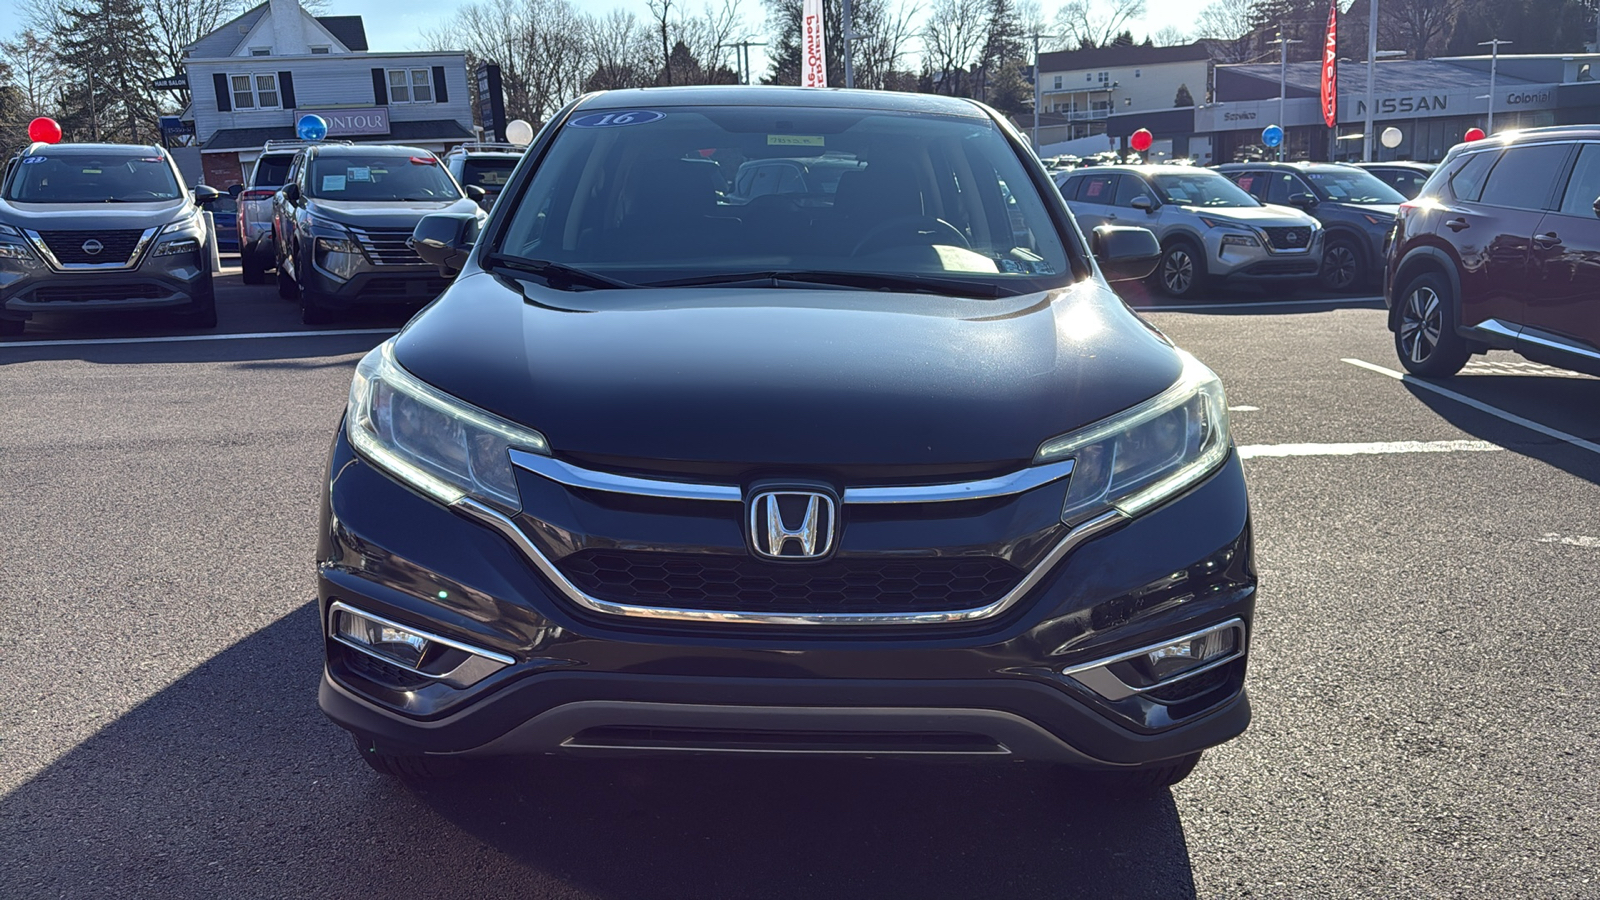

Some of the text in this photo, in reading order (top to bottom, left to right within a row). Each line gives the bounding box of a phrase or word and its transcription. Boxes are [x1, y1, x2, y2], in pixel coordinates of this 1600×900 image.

[1506, 91, 1550, 105] Colonial
[1357, 95, 1448, 116] NISSAN
[323, 115, 383, 129] ONTOUR
[593, 111, 640, 126] 16
[1223, 112, 1257, 122] Service
